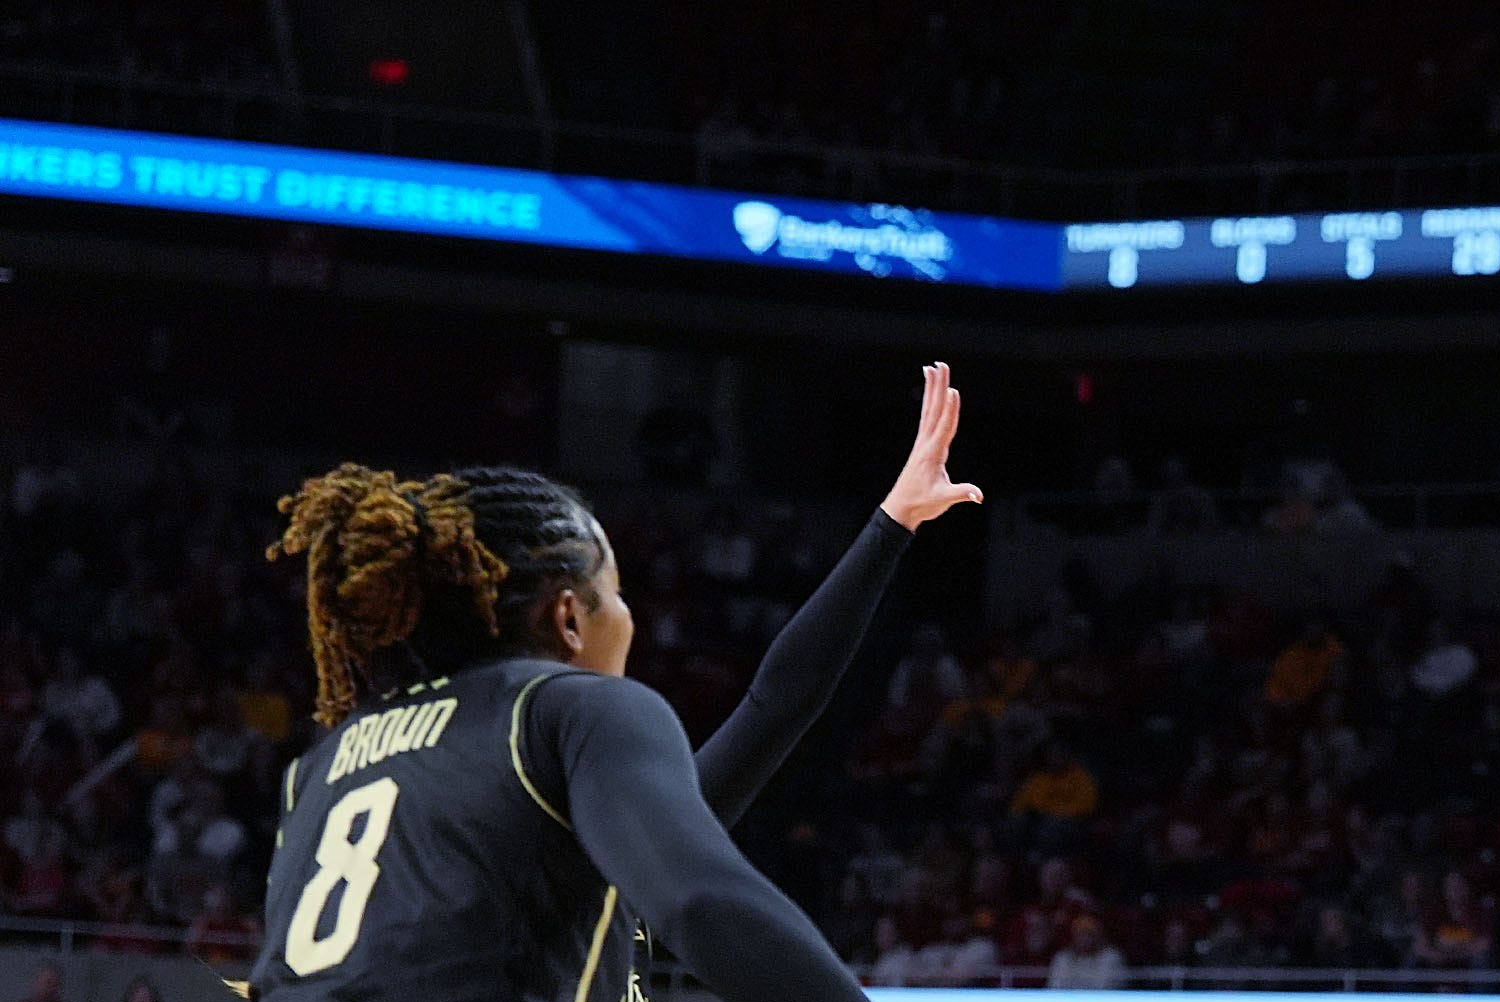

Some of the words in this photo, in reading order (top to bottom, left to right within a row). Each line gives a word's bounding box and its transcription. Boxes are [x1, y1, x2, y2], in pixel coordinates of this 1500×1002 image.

[130, 155, 271, 203] TRUST
[276, 170, 542, 230] DIFFERENCE
[325, 697, 458, 785] BROWN
[285, 776, 399, 977] 8
